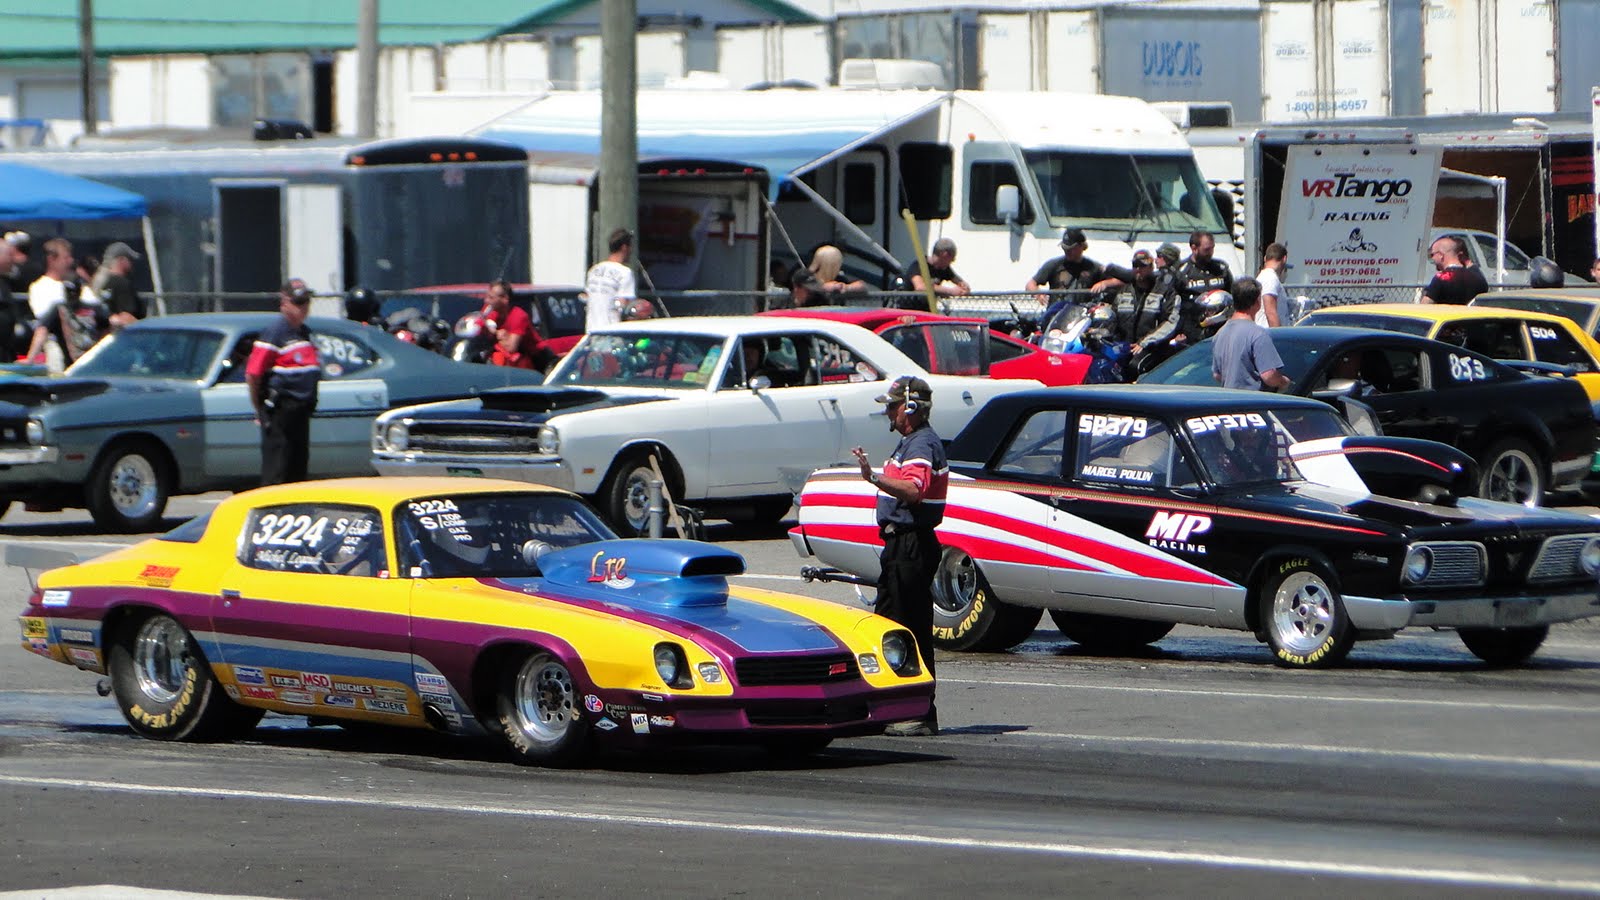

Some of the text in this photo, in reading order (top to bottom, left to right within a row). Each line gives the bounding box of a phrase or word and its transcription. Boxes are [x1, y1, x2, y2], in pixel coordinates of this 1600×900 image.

[1323, 210, 1391, 221] RACING
[1303, 257, 1399, 266] www.vrtango.com
[1530, 326, 1557, 339] 504
[1449, 352, 1486, 381] 853
[1078, 414, 1148, 438] SP379
[1186, 413, 1267, 434] SP379
[1082, 465, 1153, 482] MARCEL POULIN
[408, 499, 458, 516] 3224
[251, 513, 329, 547] 3224
[1144, 510, 1213, 542] MP
[1149, 539, 1207, 553] RACING
[1280, 558, 1310, 573] EAGLE
[303, 673, 330, 688] MSD
[334, 682, 372, 694] HUGHES
[632, 714, 647, 726] WIX
